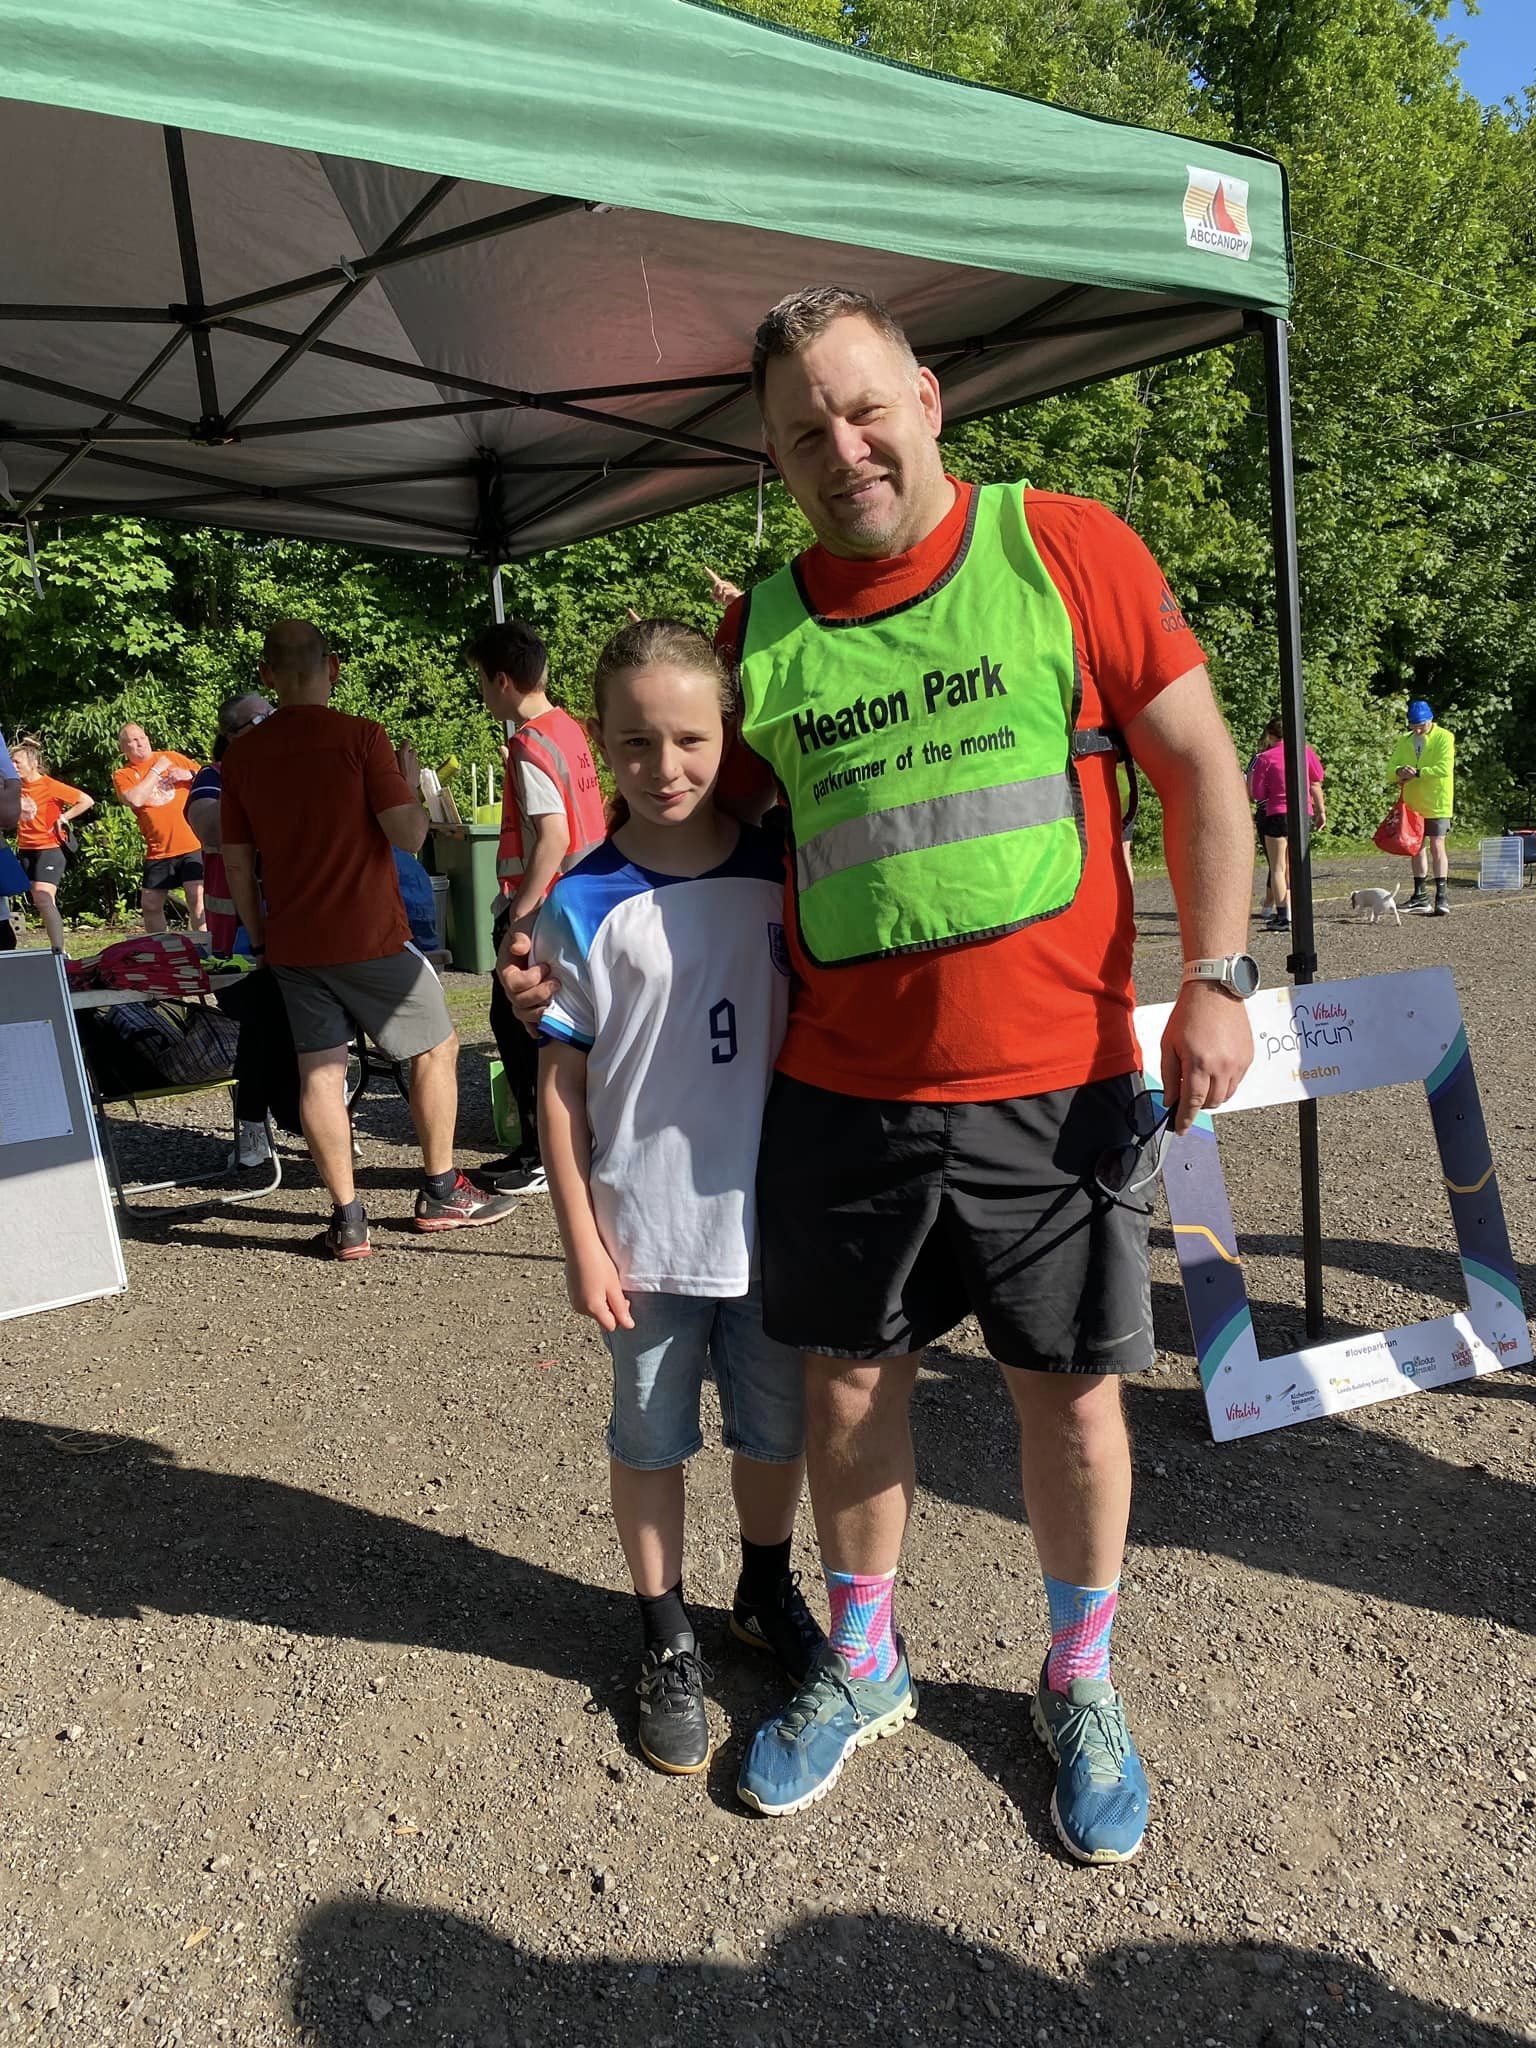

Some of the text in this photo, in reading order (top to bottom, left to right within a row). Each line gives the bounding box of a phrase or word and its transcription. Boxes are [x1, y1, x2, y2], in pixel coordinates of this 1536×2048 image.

[1190, 228, 1249, 253] ABCCANOPY
[793, 655, 1007, 755] Heaton Park
[813, 725, 1016, 805] parkrunner of the month
[1312, 1002, 1347, 1021] Vitality
[709, 997, 738, 1064] 9
[1267, 1019, 1353, 1061] parkrun
[1291, 1065, 1341, 1082] Heaton
[1345, 1339, 1399, 1357] #loveparkrun
[1226, 1401, 1261, 1421] Vitality
